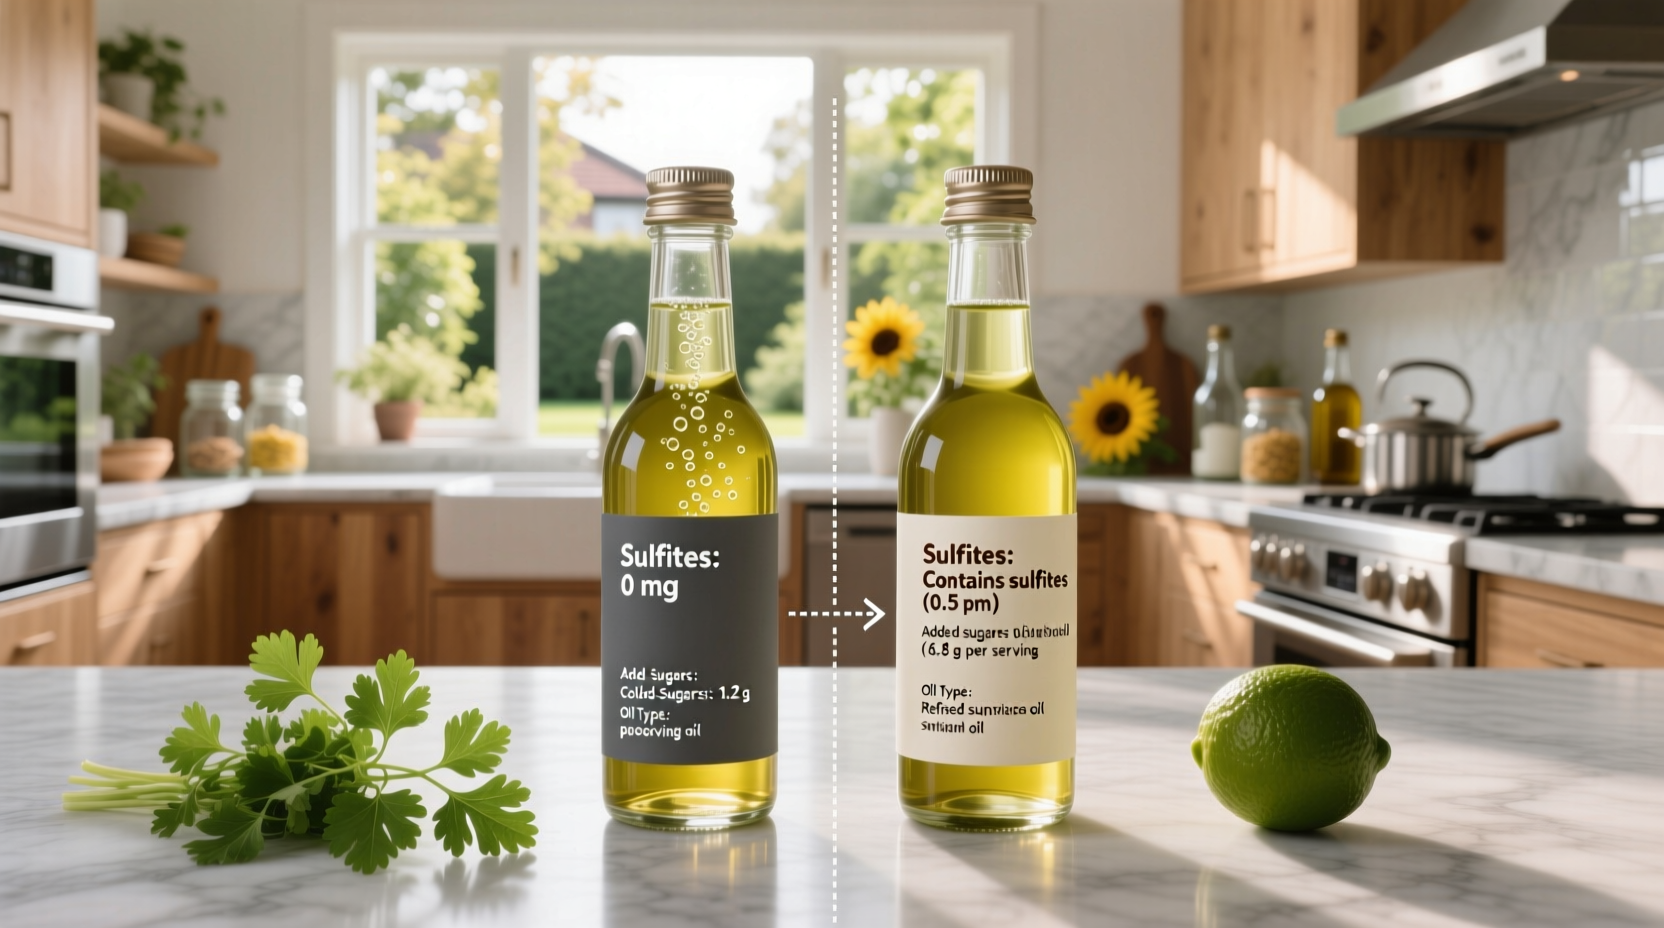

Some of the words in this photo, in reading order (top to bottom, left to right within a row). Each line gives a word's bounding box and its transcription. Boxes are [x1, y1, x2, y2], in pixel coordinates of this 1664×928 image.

[620, 542, 720, 569] Sulfites:
[923, 542, 1014, 565] Sulfites:
[620, 573, 635, 597] 0
[640, 579, 679, 604] mg
[922, 569, 1005, 589] Contains
[1008, 569, 1069, 590] sulfites
[922, 591, 959, 614] (0.5
[963, 591, 1000, 616] pm)
[921, 624, 960, 638] Added
[953, 646, 962, 660] g
[965, 646, 988, 660] per
[991, 643, 1039, 660] serving
[619, 666, 646, 681] Add
[718, 684, 741, 700] 1.2
[741, 688, 751, 703] g
[940, 684, 973, 701] Type:
[636, 706, 671, 726] Type:
[968, 720, 985, 734] oil
